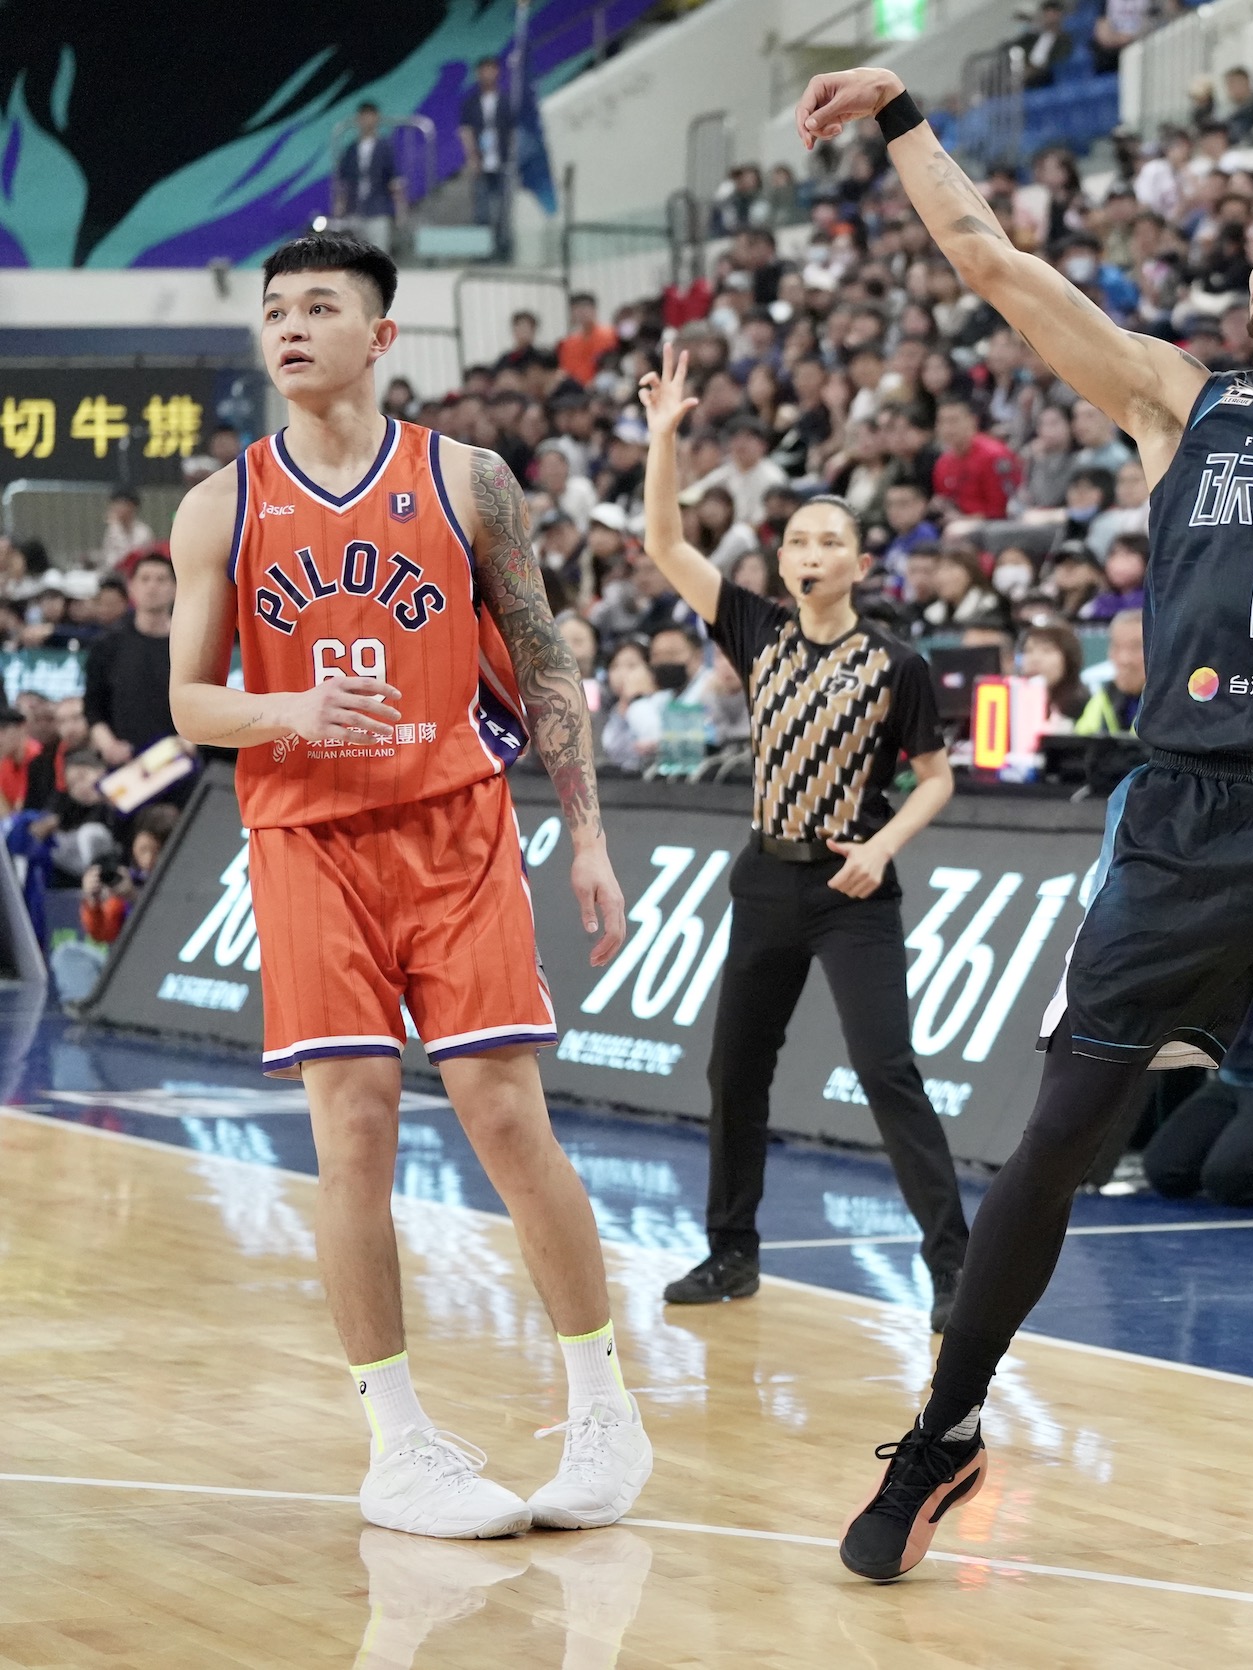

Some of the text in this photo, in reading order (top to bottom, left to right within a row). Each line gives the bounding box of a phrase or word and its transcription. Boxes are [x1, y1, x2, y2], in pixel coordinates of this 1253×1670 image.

[254, 539, 446, 636] PILOTS
[312, 638, 387, 703] 69
[339, 748, 395, 758] ARCHILAND
